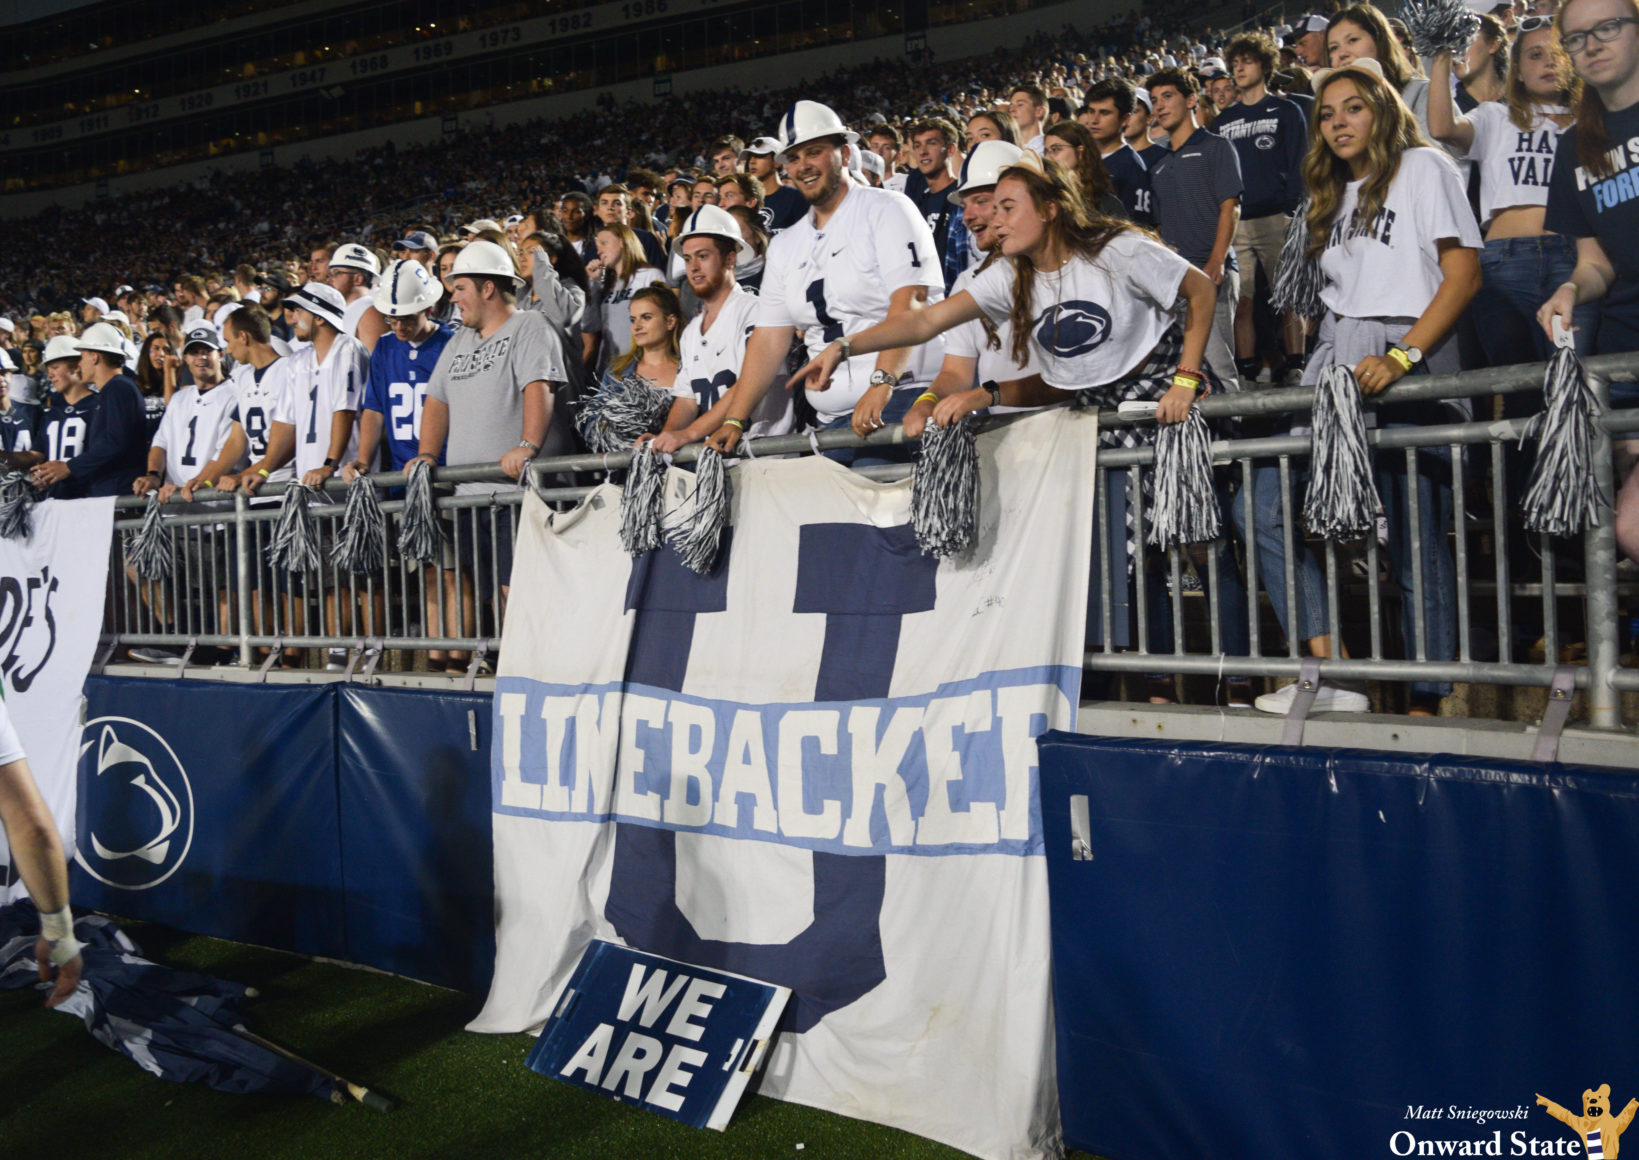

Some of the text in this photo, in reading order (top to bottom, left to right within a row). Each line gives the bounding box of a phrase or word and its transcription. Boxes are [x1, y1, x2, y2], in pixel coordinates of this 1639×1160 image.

[234, 79, 269, 99] 1921
[290, 67, 327, 88] 1947
[351, 54, 389, 75] 1968
[413, 41, 454, 62] 1969
[479, 26, 521, 49] 1973
[549, 12, 592, 34] 1982
[1515, 130, 1558, 155] HA
[907, 242, 921, 268] 1
[806, 278, 844, 343] 1
[346, 370, 355, 393] 1
[46, 417, 86, 462] 18
[246, 406, 268, 456] 9
[306, 385, 318, 444] 1
[181, 415, 198, 466] 1
[616, 963, 727, 1042] WE
[560, 1022, 709, 1112] ARE
